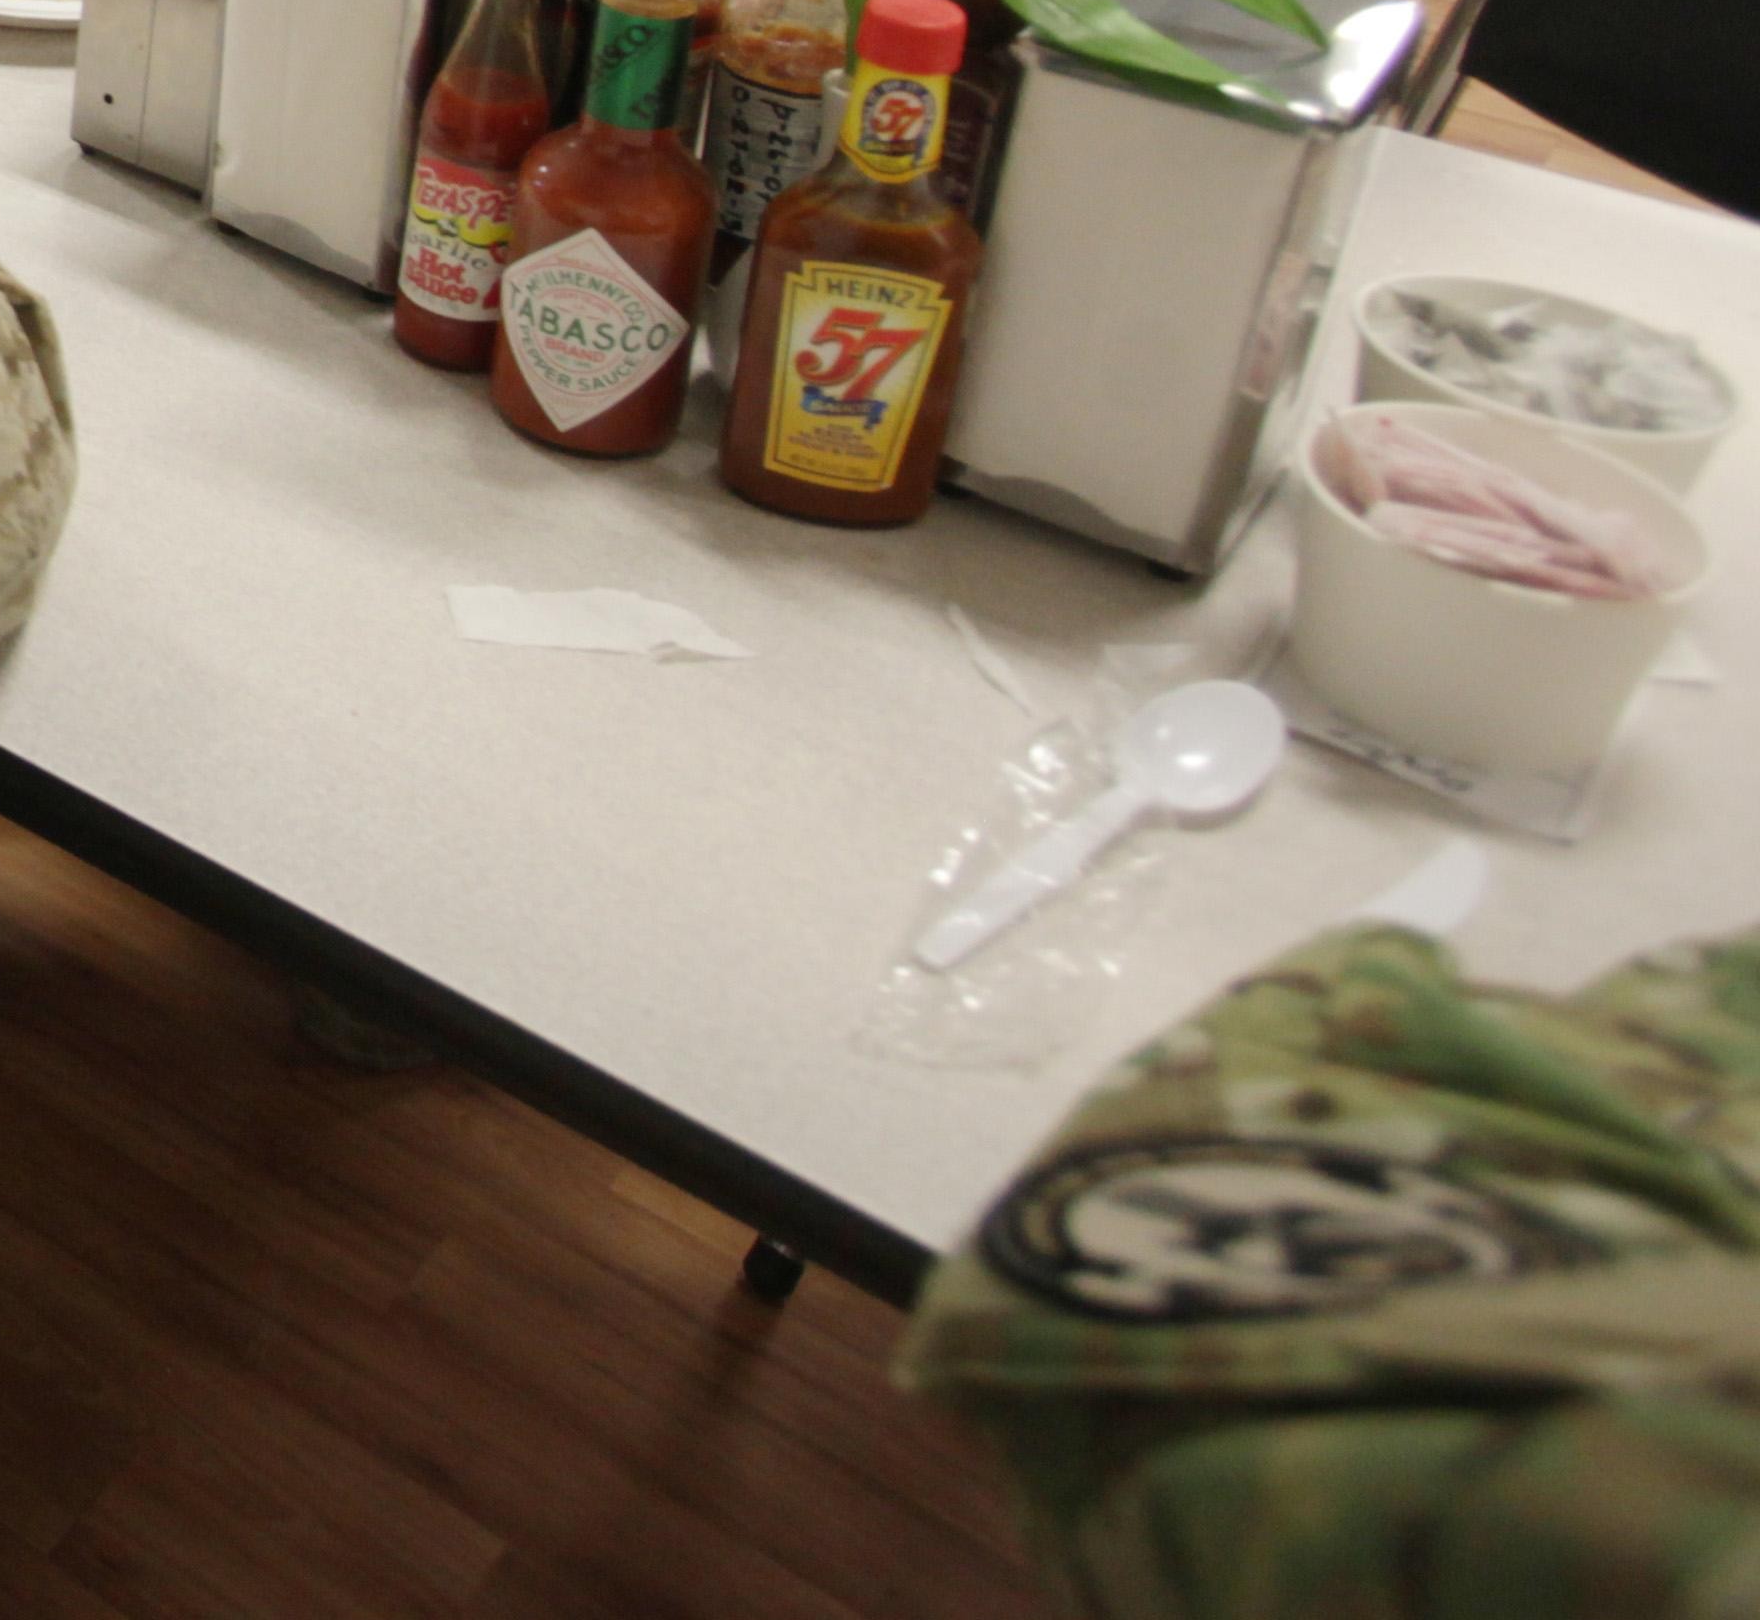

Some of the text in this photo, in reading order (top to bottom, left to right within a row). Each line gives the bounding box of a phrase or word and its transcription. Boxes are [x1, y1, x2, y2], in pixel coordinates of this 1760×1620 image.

[868, 98, 925, 141] 57
[405, 255, 478, 305] Sauce
[420, 246, 465, 284] Hot
[826, 278, 914, 308] HEINZ
[509, 281, 670, 353] TABASCO
[520, 324, 638, 392] PEPPER SAUCE
[545, 337, 606, 363] BRAND
[795, 307, 927, 402] 57
